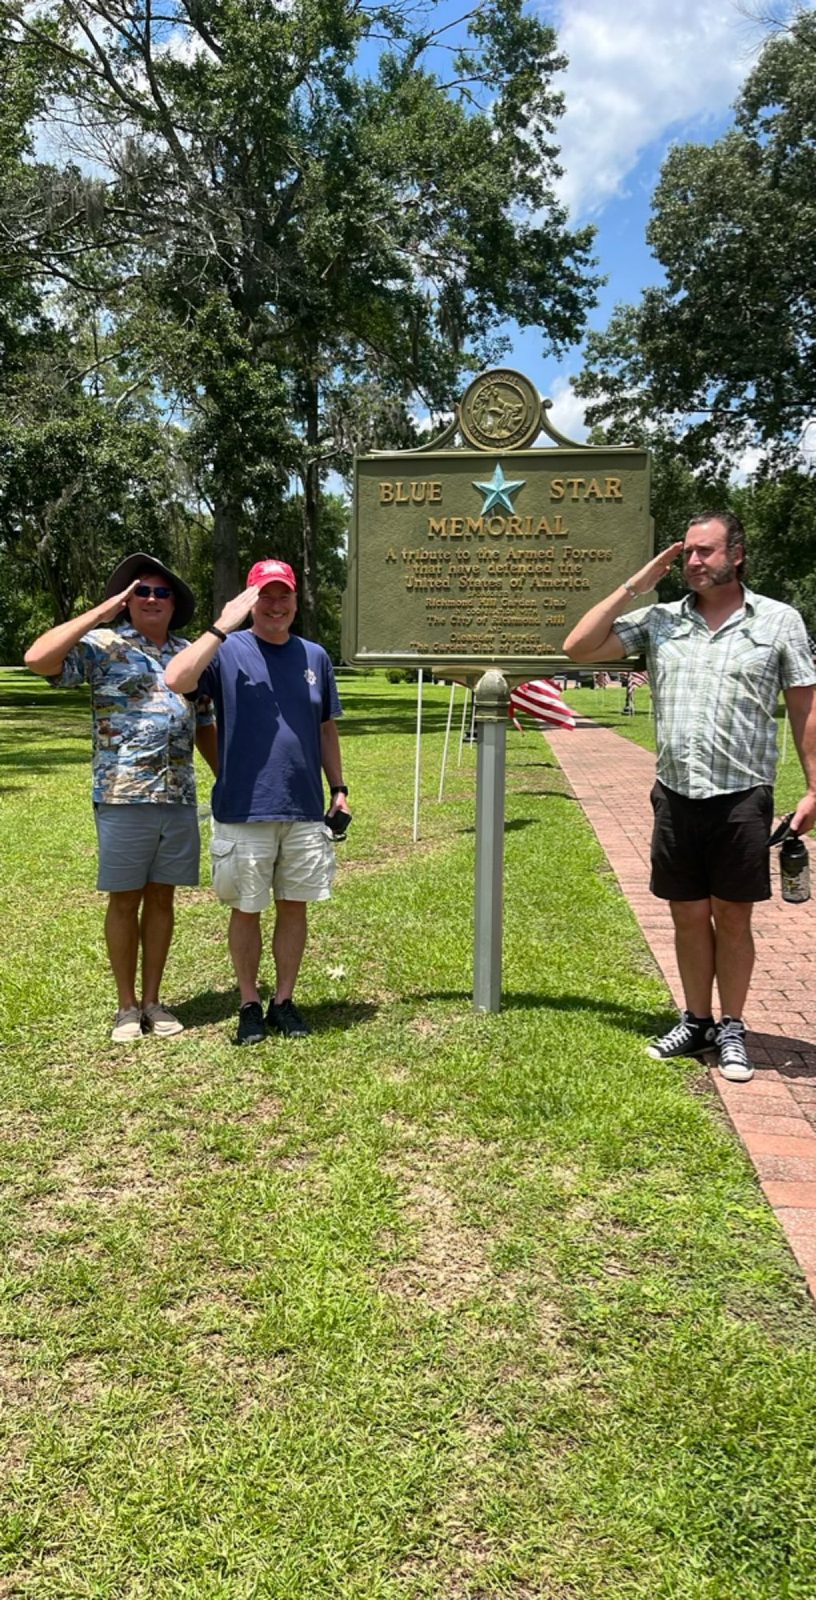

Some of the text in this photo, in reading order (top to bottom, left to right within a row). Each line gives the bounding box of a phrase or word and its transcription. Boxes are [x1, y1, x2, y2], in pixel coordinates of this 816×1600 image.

[379, 477, 623, 502] BLUE STAR
[427, 515, 569, 537] MEMORIAL
[385, 545, 613, 563] A tribute to the Armed Forces
[412, 561, 582, 578] that have defended the
[405, 576, 591, 592] United States of America
[501, 597, 537, 609] Garden
[450, 615, 473, 627] City
